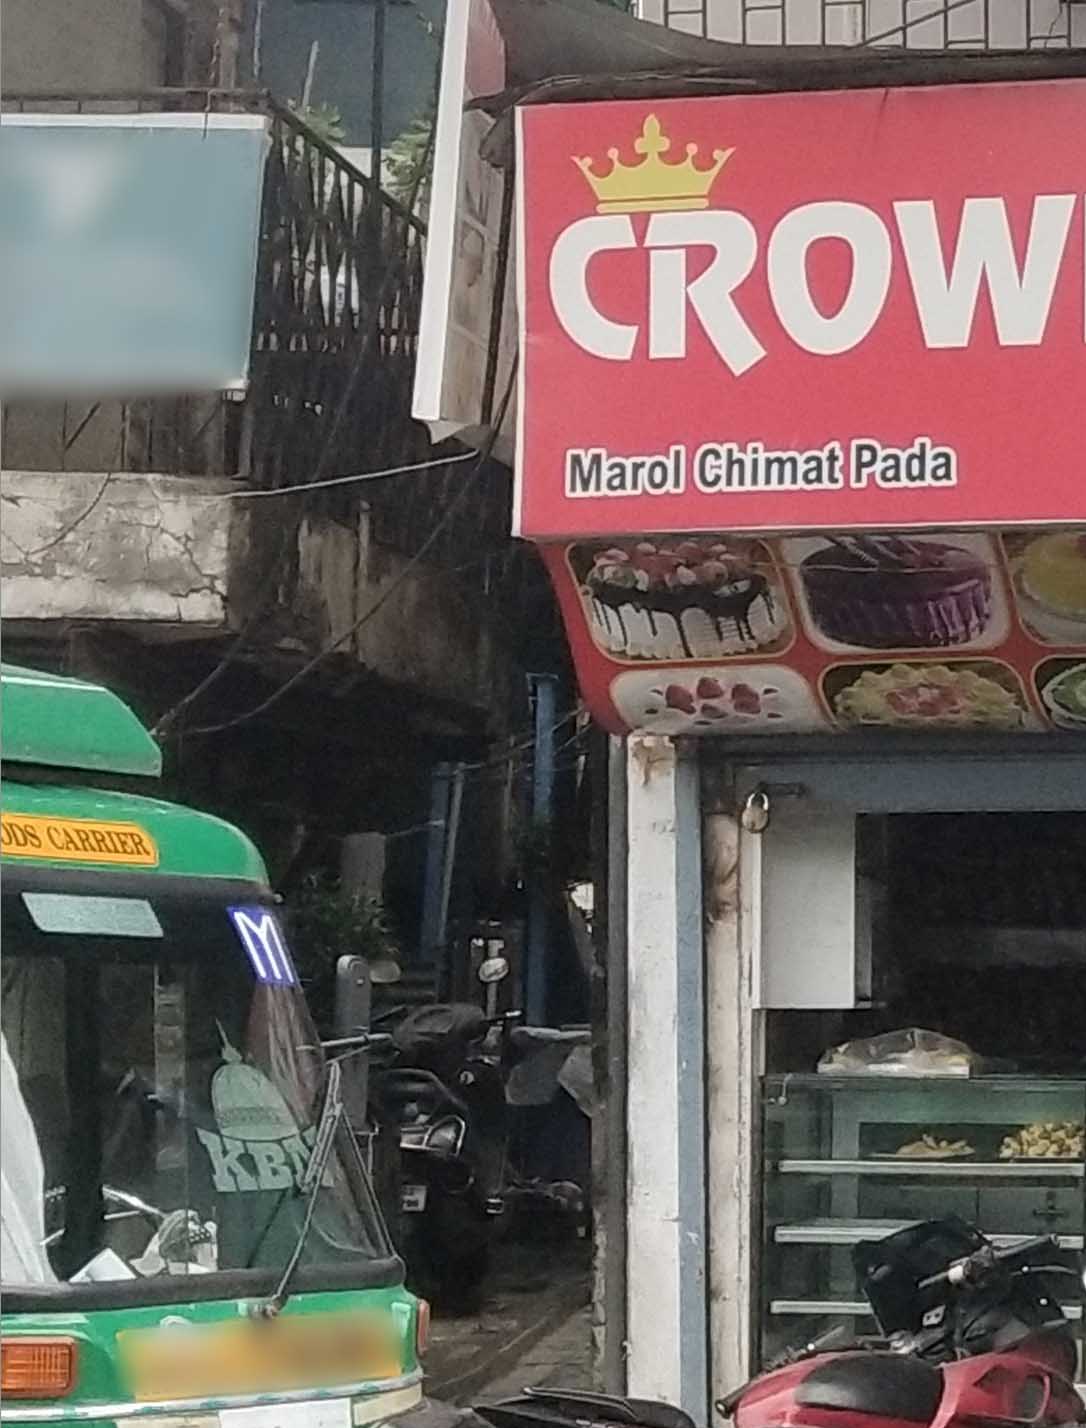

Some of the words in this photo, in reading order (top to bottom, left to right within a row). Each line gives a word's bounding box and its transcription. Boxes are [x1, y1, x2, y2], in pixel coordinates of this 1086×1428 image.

[567, 447, 683, 494] Marol
[697, 444, 841, 490] Chimat
[852, 440, 954, 485] Pada
[46, 825, 151, 856] CARRIER
